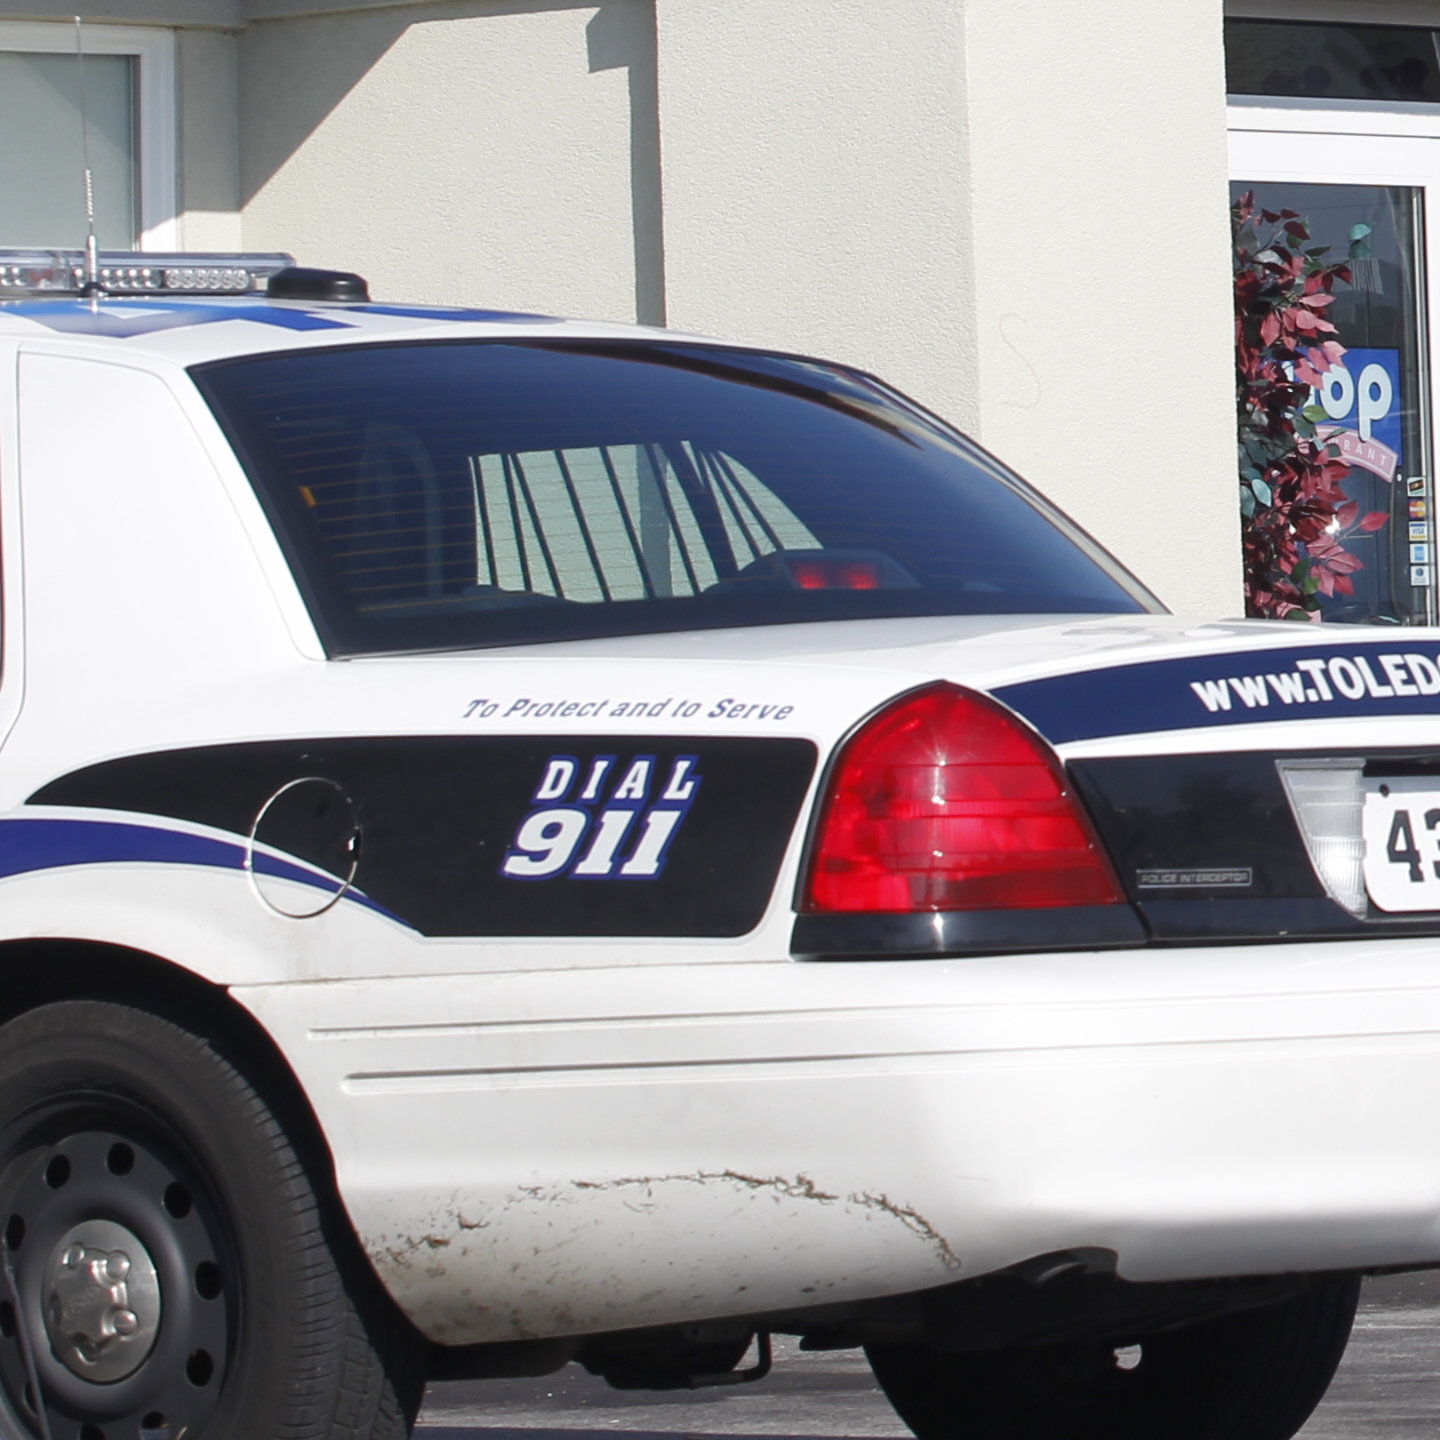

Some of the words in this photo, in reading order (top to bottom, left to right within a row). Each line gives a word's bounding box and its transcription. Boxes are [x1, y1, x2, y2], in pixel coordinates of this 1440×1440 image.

[463, 699, 499, 718] To
[502, 698, 604, 718] Protect
[609, 698, 674, 718] and
[671, 699, 702, 718] to
[707, 699, 795, 721] Serve
[535, 760, 695, 800] DIAL
[503, 809, 682, 876] 911
[1141, 873, 1178, 883] POLICE
[1179, 872, 1249, 882] INTERCEPTOR
